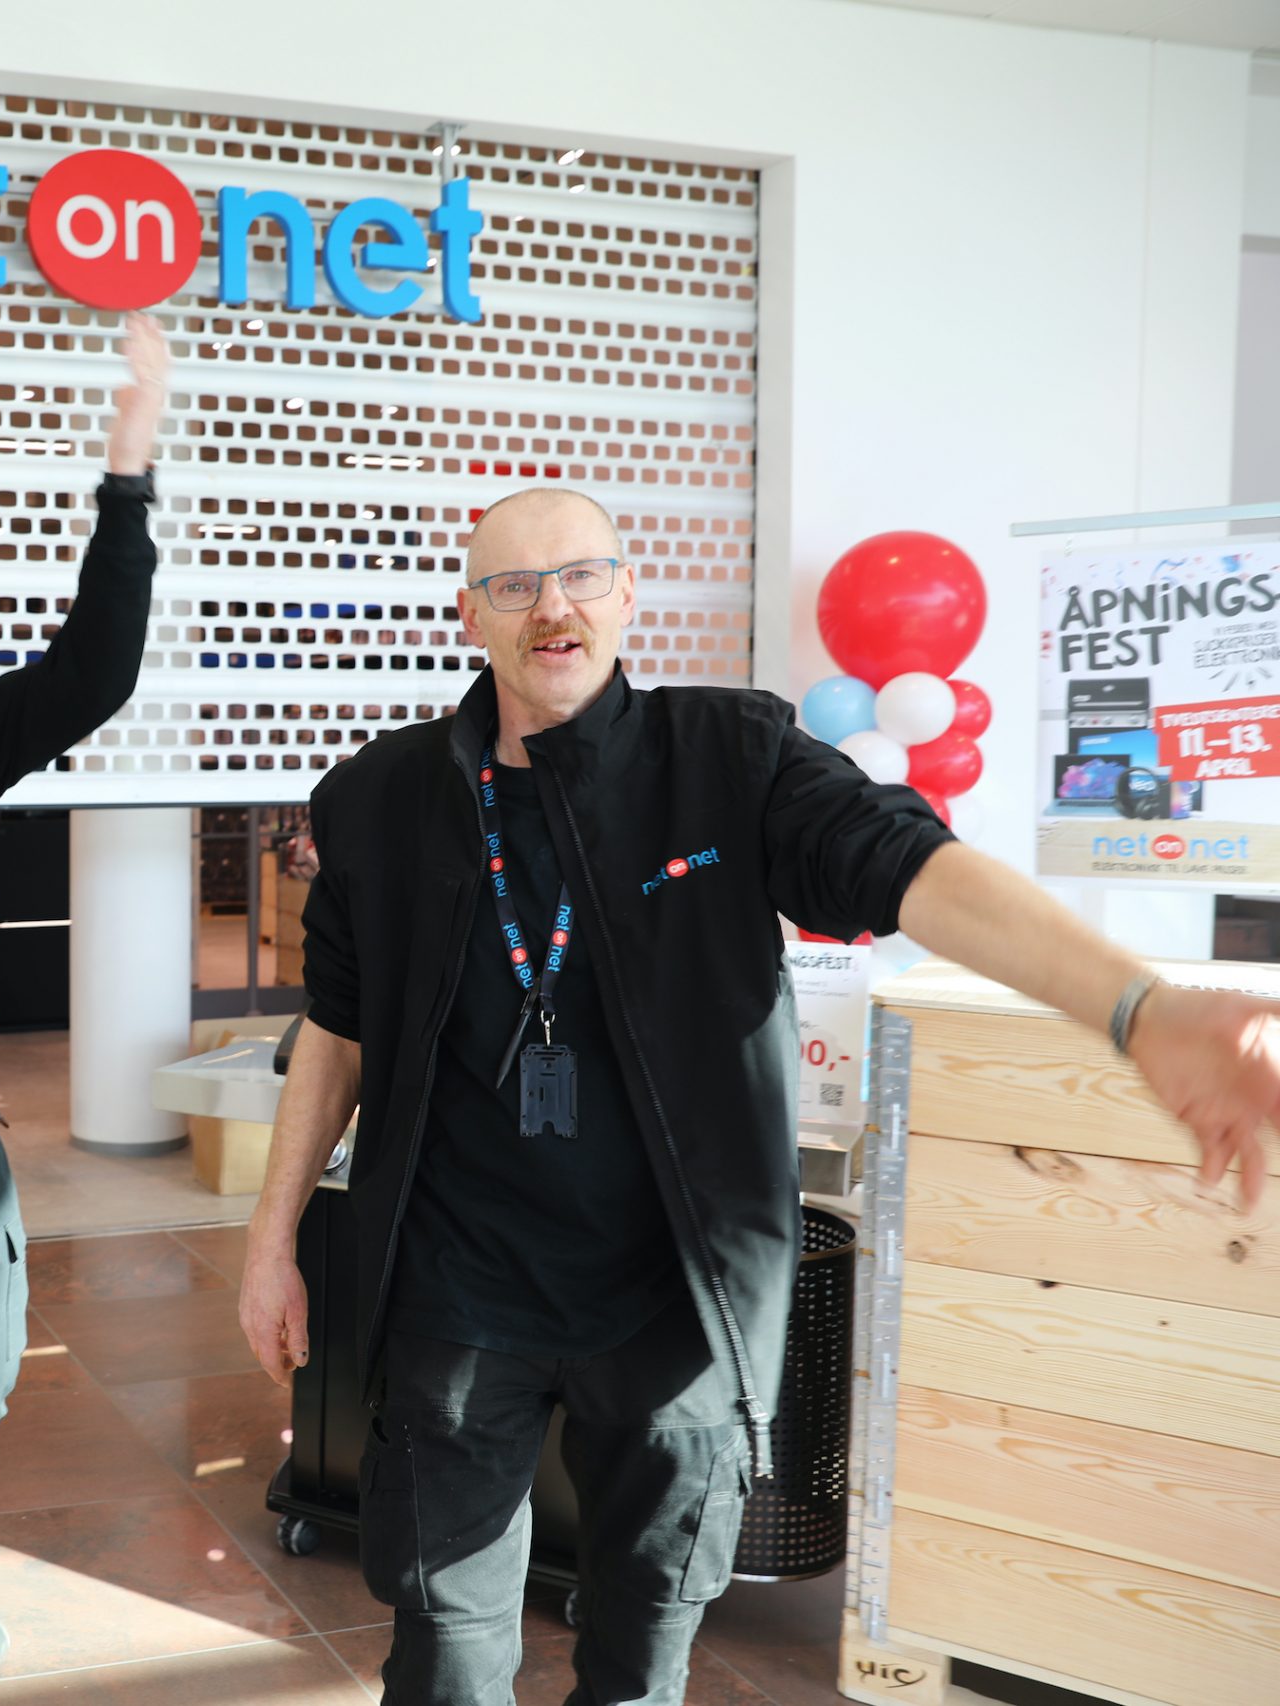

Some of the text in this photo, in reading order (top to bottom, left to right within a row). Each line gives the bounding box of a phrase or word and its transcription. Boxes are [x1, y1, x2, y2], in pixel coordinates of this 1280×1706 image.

[56, 193, 176, 264] on
[218, 177, 483, 322] net
[1060, 626, 1170, 673] FEST
[1194, 757, 1256, 778] APRIL
[480, 782, 495, 807] net
[485, 832, 501, 857] net
[1092, 833, 1149, 857] net
[1188, 835, 1249, 859] net
[669, 862, 687, 873] on
[686, 847, 720, 869] net
[491, 871, 508, 897] net
[556, 905, 571, 931] net
[502, 922, 522, 949] net
[547, 945, 563, 972] net
[515, 962, 534, 989] net
